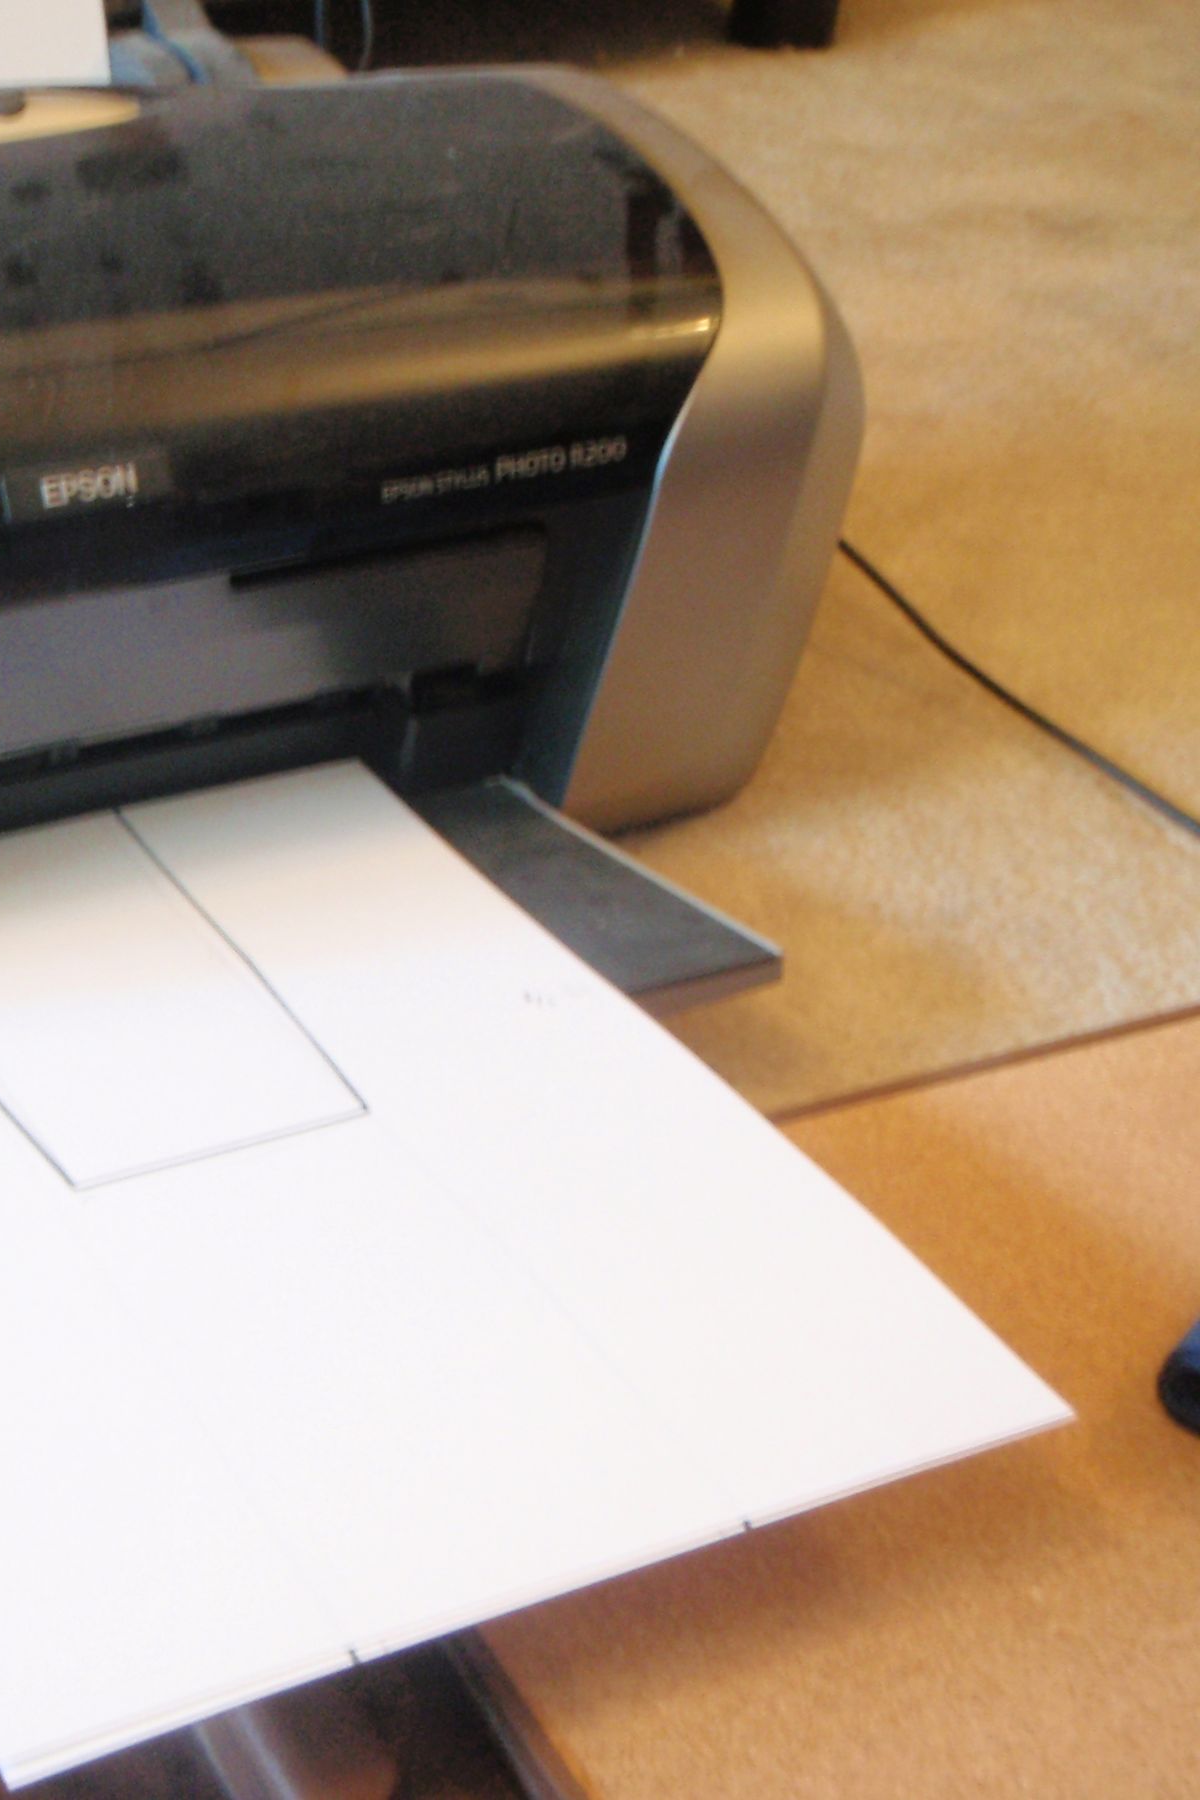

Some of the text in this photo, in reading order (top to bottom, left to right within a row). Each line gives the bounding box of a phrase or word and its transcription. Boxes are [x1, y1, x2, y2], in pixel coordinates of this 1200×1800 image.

[495, 446, 567, 482] PHOTO
[569, 435, 628, 469] R200
[40, 461, 139, 509] EPSON
